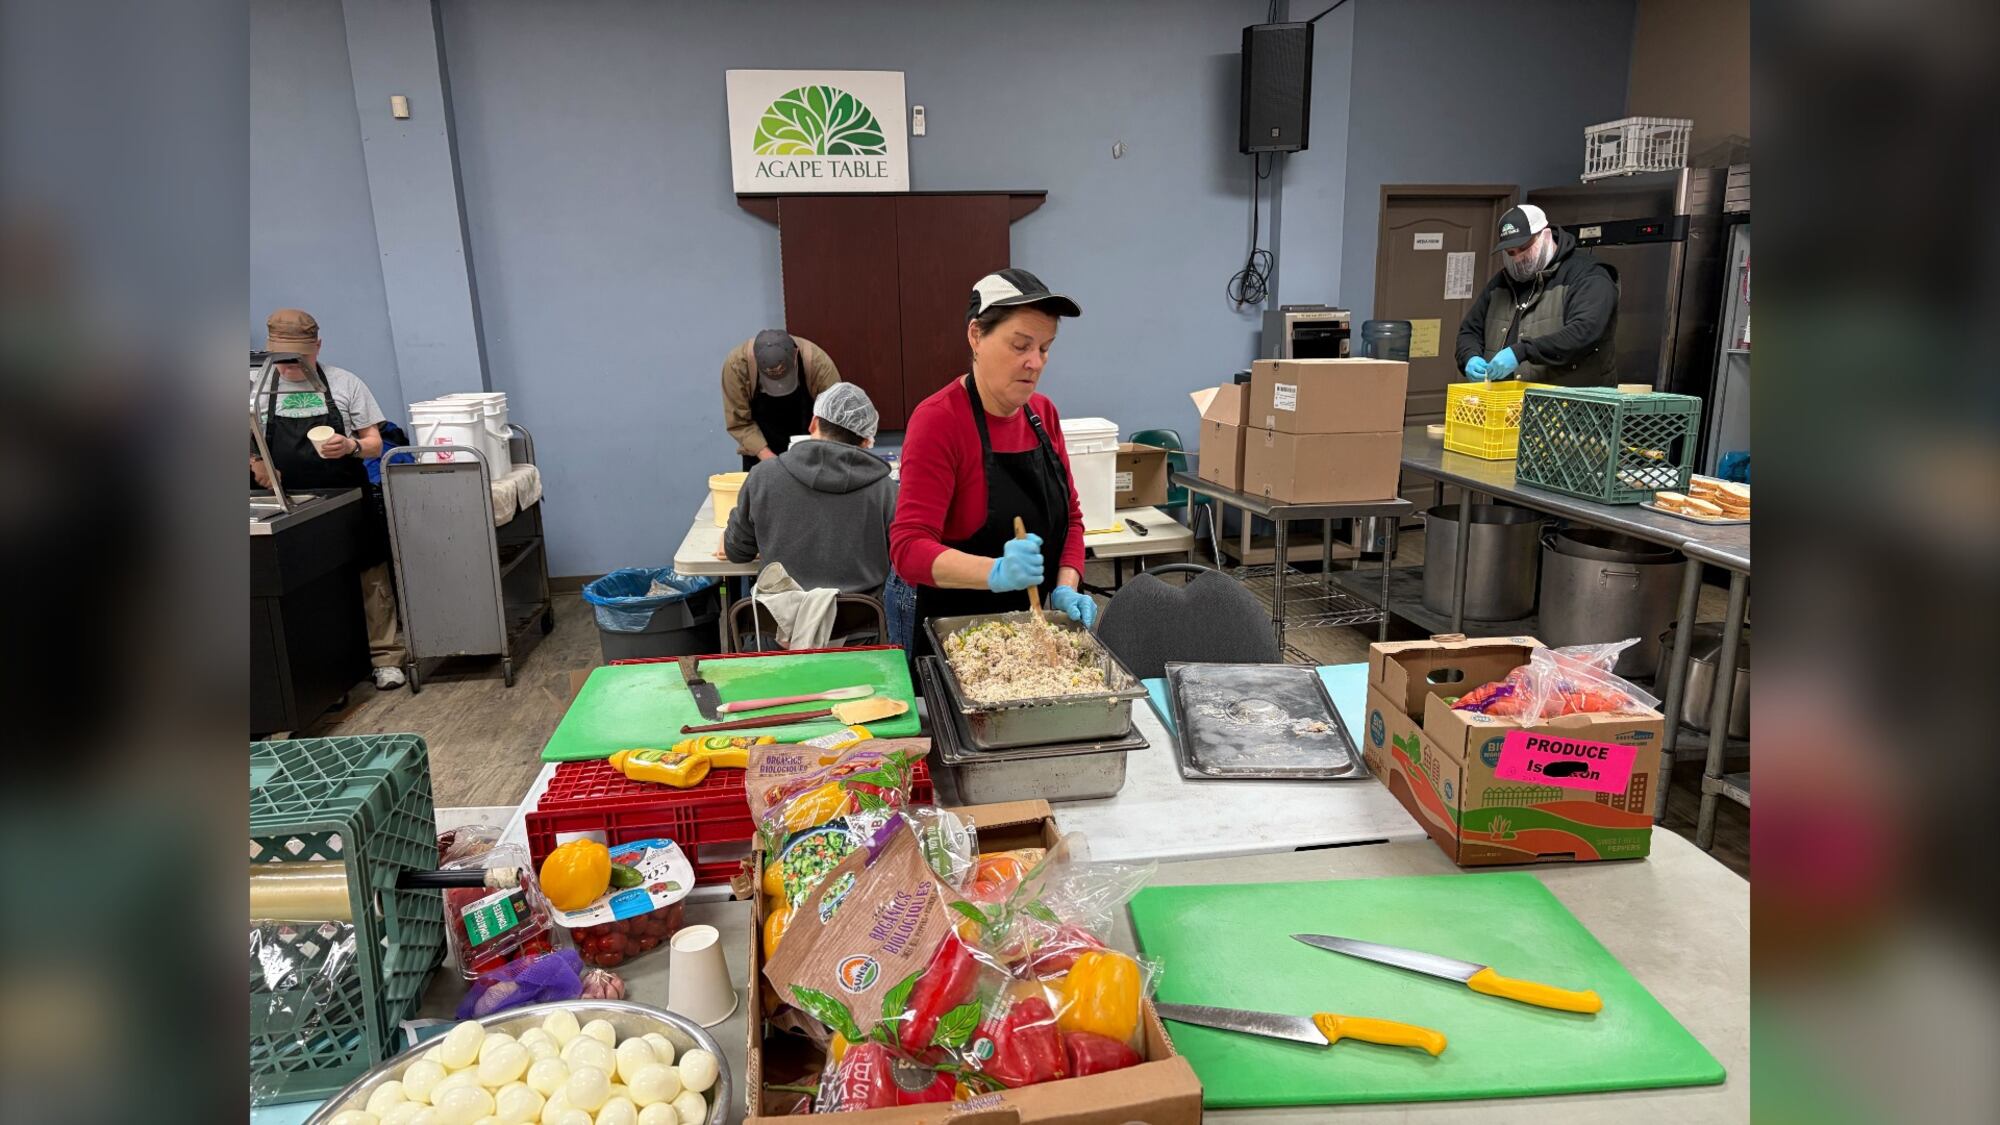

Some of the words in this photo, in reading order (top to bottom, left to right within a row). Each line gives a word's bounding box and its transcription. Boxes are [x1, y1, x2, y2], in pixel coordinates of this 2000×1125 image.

[755, 160, 823, 178] AGAPE
[827, 160, 889, 178] TABLE
[1526, 737, 1609, 760] PRODUCE
[869, 889, 912, 941] ORGANICS
[883, 880, 932, 955] BIOLOGIQUES
[854, 957, 877, 992] SUNSET
